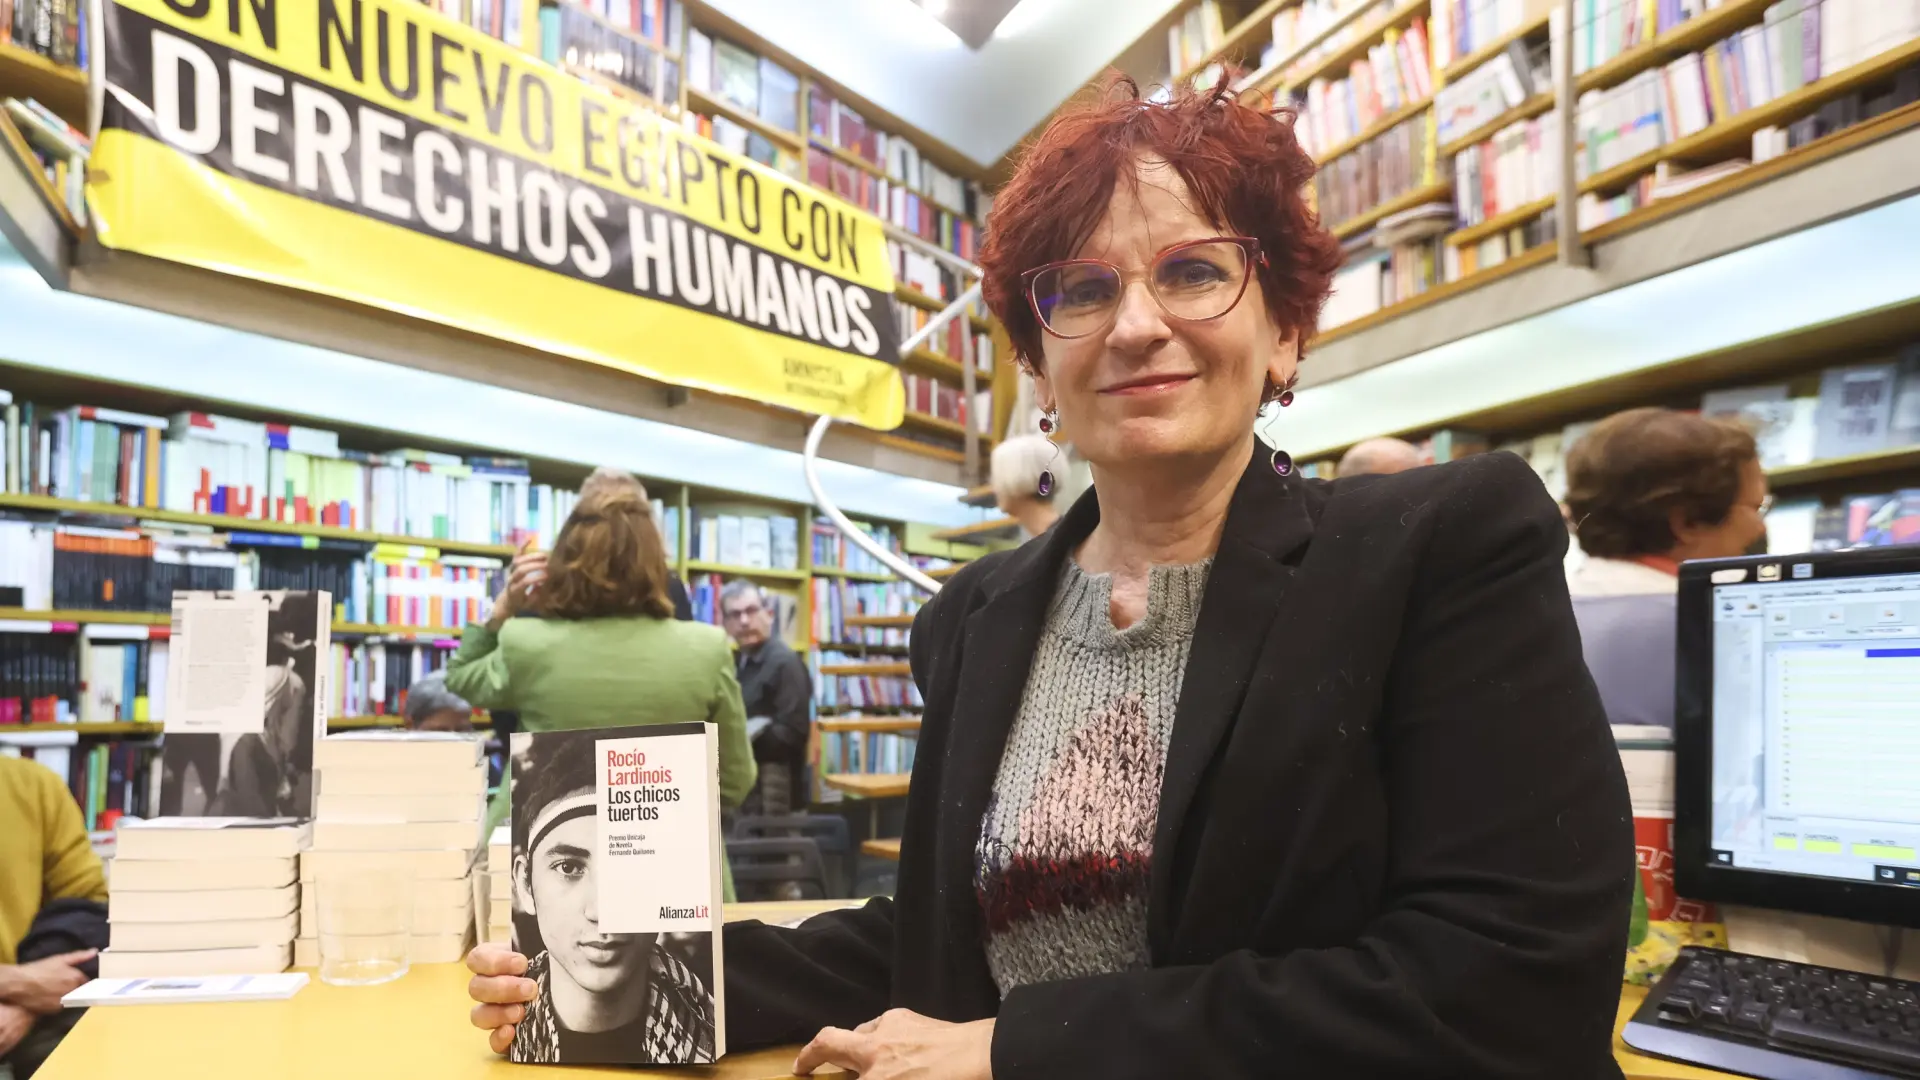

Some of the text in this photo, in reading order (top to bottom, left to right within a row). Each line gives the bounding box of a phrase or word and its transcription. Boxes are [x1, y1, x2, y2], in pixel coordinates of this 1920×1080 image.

[318, 0, 555, 154] NUEVO
[581, 96, 761, 236] EGIPTO
[781, 187, 861, 274] CON
[150, 27, 881, 357] DERECHOS HUMANOS
[607, 748, 646, 768] Rocío
[607, 766, 672, 786] Lardinois
[608, 785, 680, 805] Los chicos
[607, 804, 659, 822] tuertos
[608, 834, 626, 842] Premio
